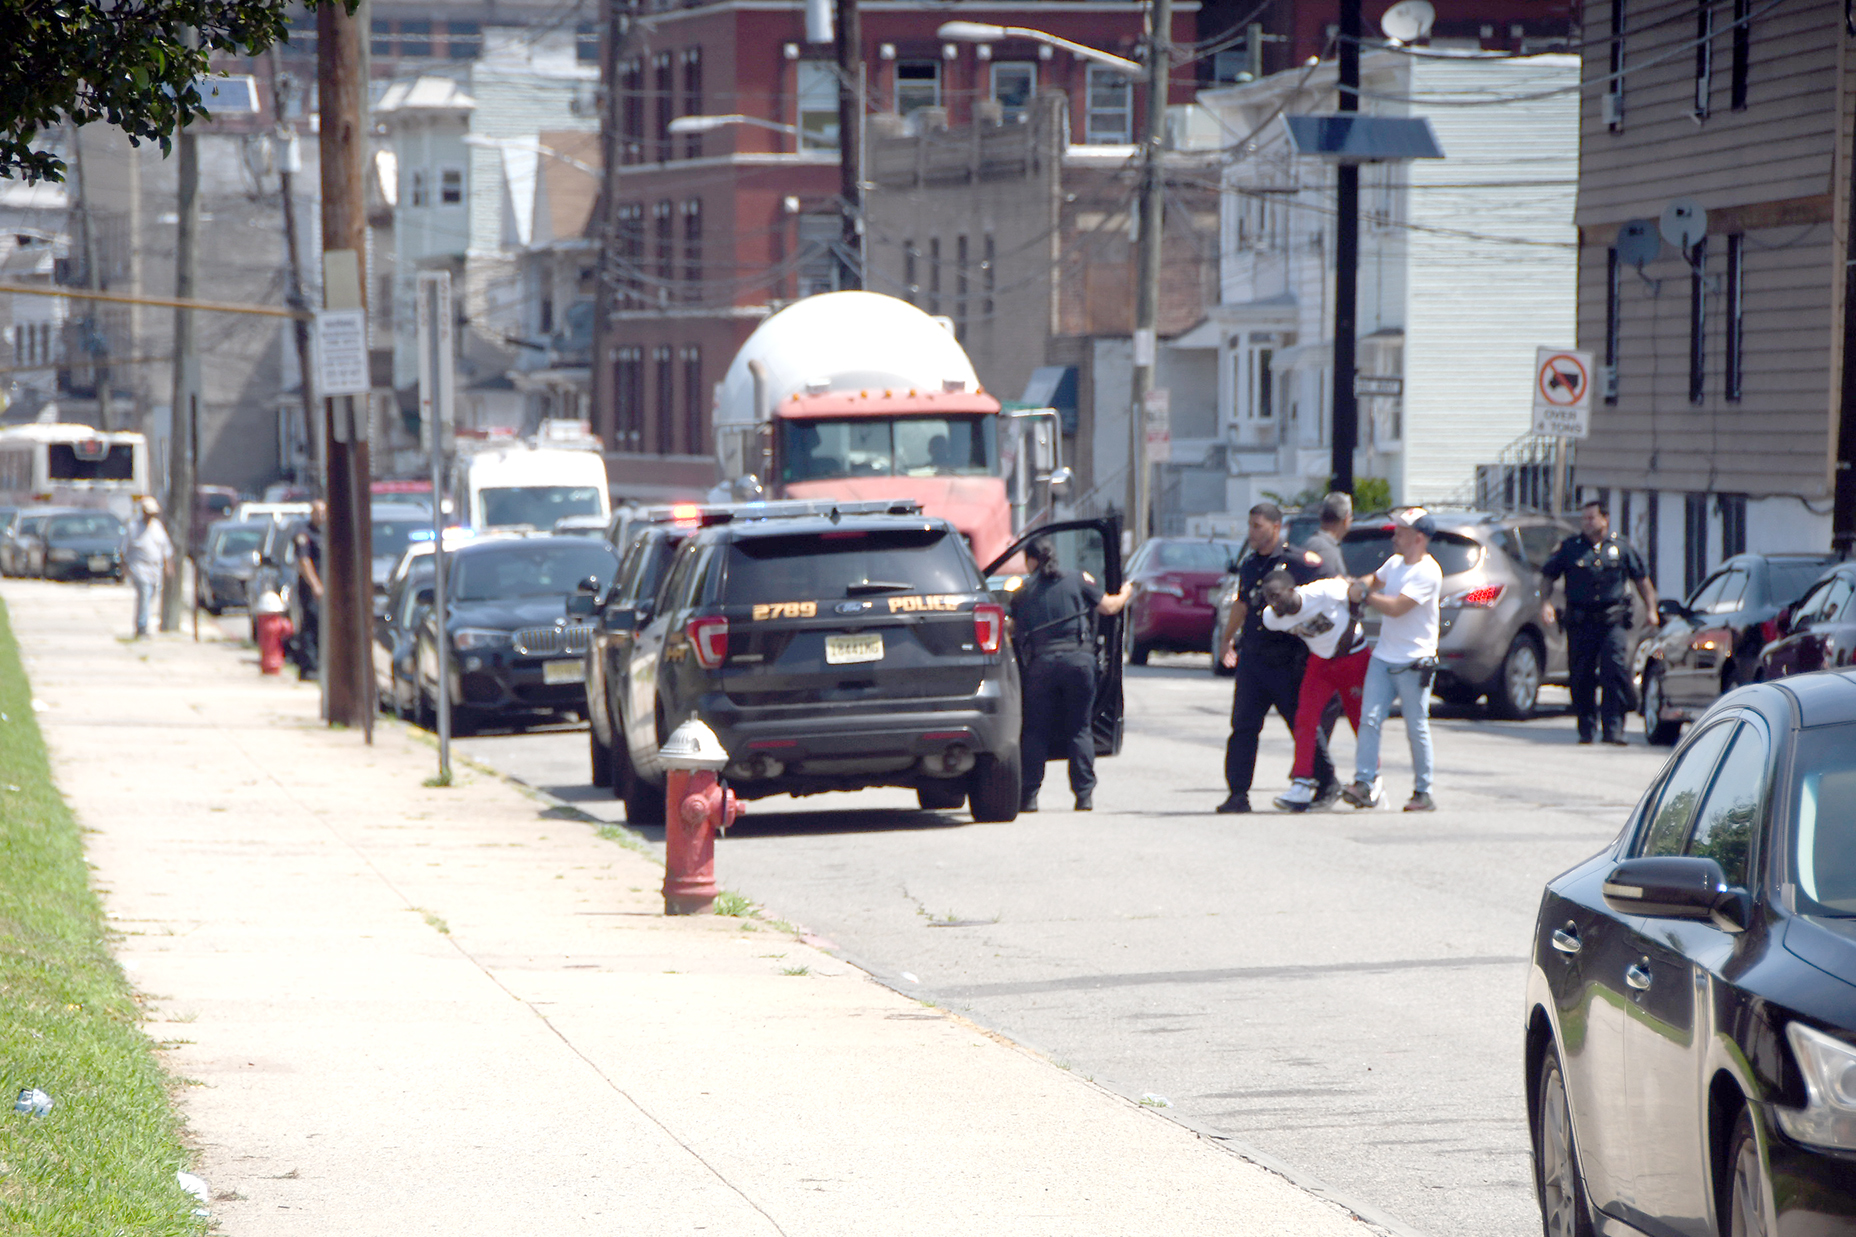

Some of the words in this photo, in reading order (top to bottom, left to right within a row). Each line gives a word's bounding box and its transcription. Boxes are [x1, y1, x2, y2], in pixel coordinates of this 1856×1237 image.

[1543, 409, 1577, 420] OVER
[1551, 422, 1583, 433] TONS
[752, 601, 818, 621] 2789
